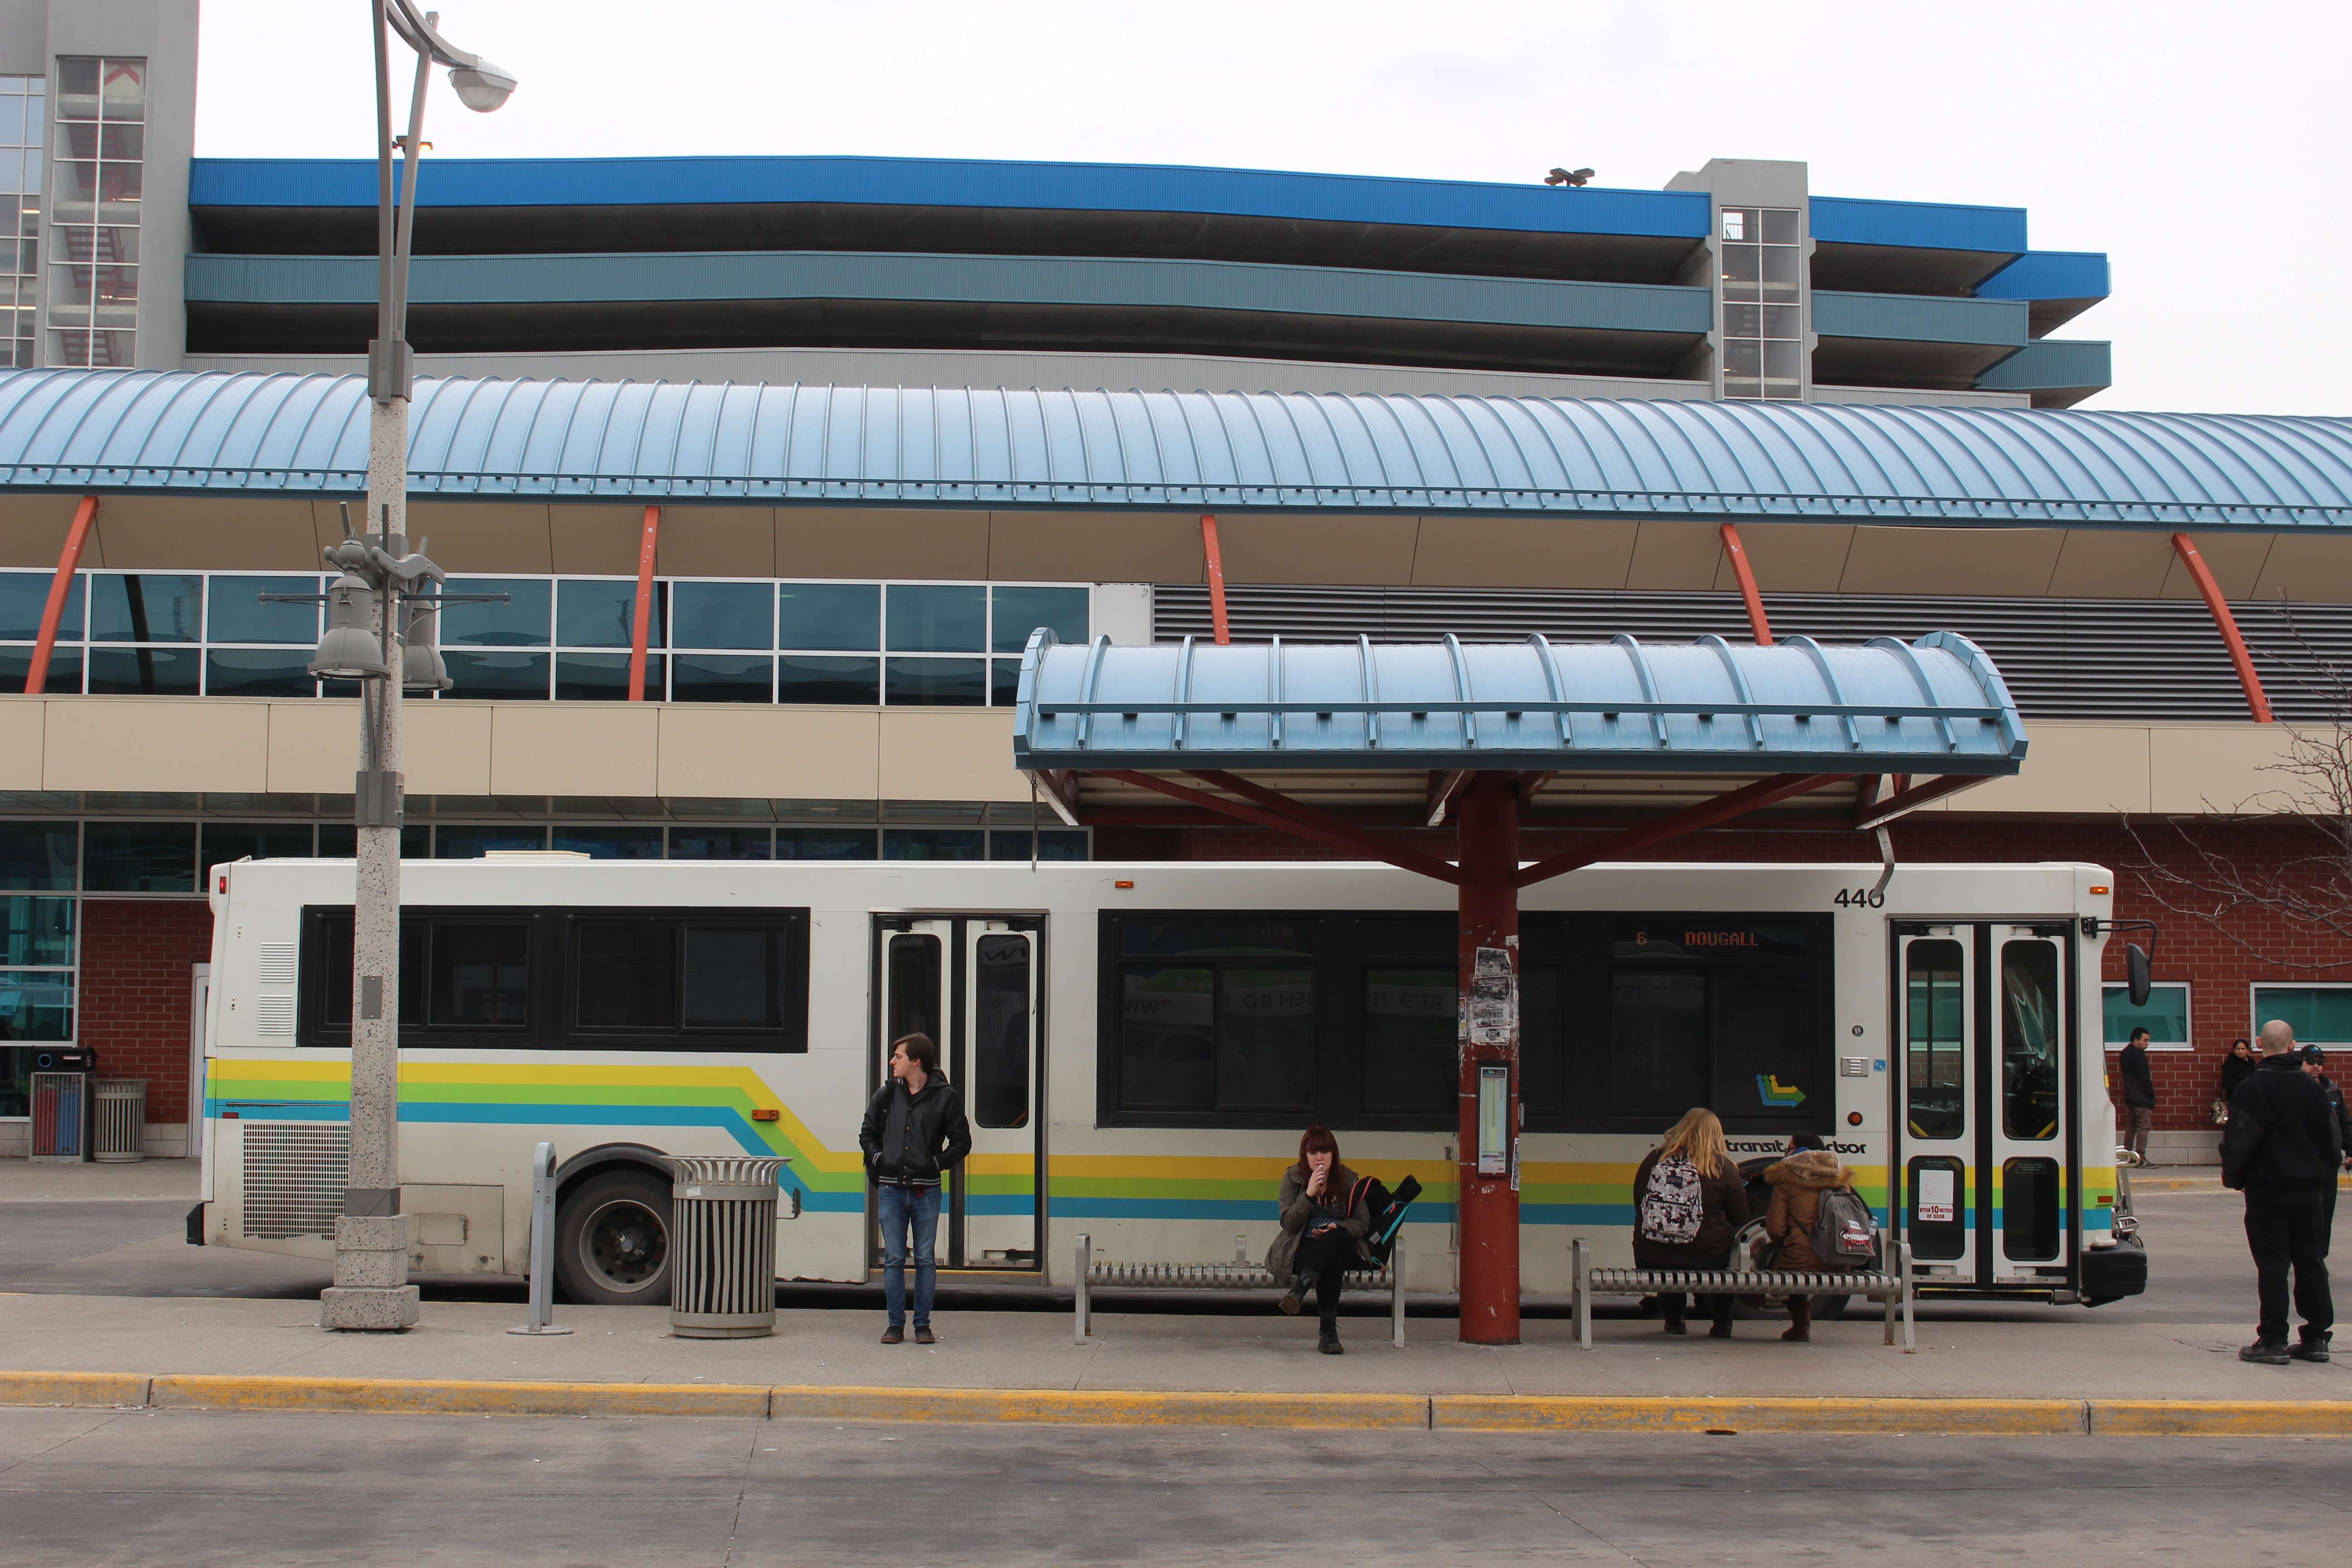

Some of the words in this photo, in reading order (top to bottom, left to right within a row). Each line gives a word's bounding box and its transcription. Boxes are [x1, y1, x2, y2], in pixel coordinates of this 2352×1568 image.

[1834, 888, 1884, 908] 440
[1637, 932, 1646, 945] 6
[1685, 932, 1758, 946] DOUGALL
[1725, 1140, 1785, 1152] transit
[1931, 1205, 1939, 1214] 10
